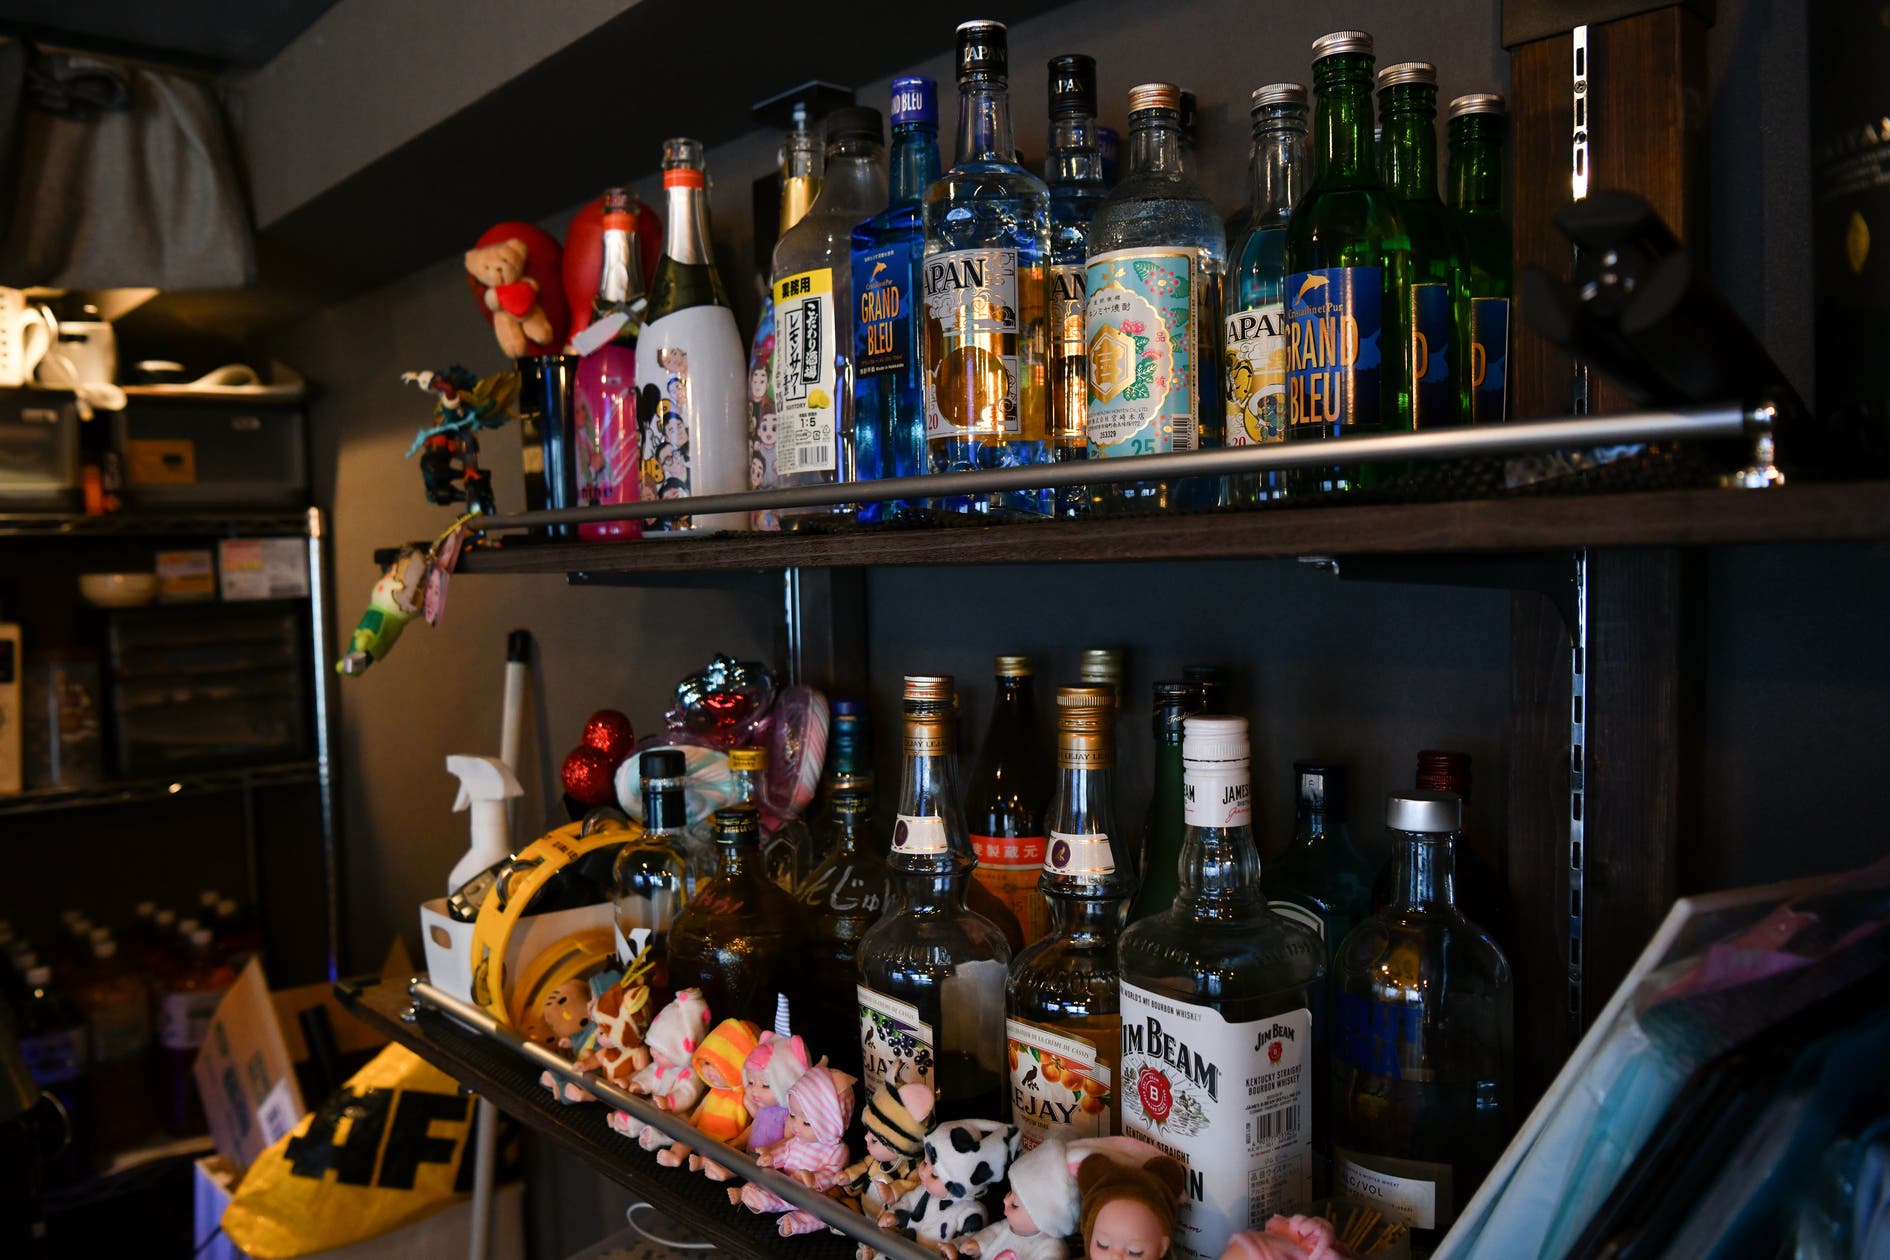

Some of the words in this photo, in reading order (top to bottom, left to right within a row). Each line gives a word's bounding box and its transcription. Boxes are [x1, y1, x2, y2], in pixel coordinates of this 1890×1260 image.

[901, 92, 922, 112] BLEU
[782, 277, 810, 299] 業務用
[861, 286, 899, 323] GRAND
[803, 302, 819, 380] こだわり酒場
[867, 321, 893, 355] BLEU
[789, 314, 801, 397] レモンサワー
[1290, 371, 1341, 425] BLEU
[800, 417, 816, 428] 1:5
[928, 414, 939, 430] 20
[1131, 439, 1156, 456] 25
[1232, 436, 1247, 447] 20
[1222, 783, 1249, 805] JAMES
[1151, 1000, 1175, 1015] BOURBON
[1175, 1008, 1202, 1022] WHISKEY
[1255, 1028, 1272, 1052] JIM
[1272, 1023, 1295, 1041] BEAM
[1146, 1015, 1218, 1103] BEAM
[1245, 1072, 1276, 1088] KENTUCKY
[1276, 1063, 1302, 1080] STRAIGHT
[1248, 1081, 1276, 1097] BOURBON
[1276, 1074, 1300, 1089] WHISKEY
[1150, 1085, 1159, 1101] B
[1125, 1124, 1155, 1146] KENTUCKY
[1156, 1141, 1191, 1165] STRAIGHT
